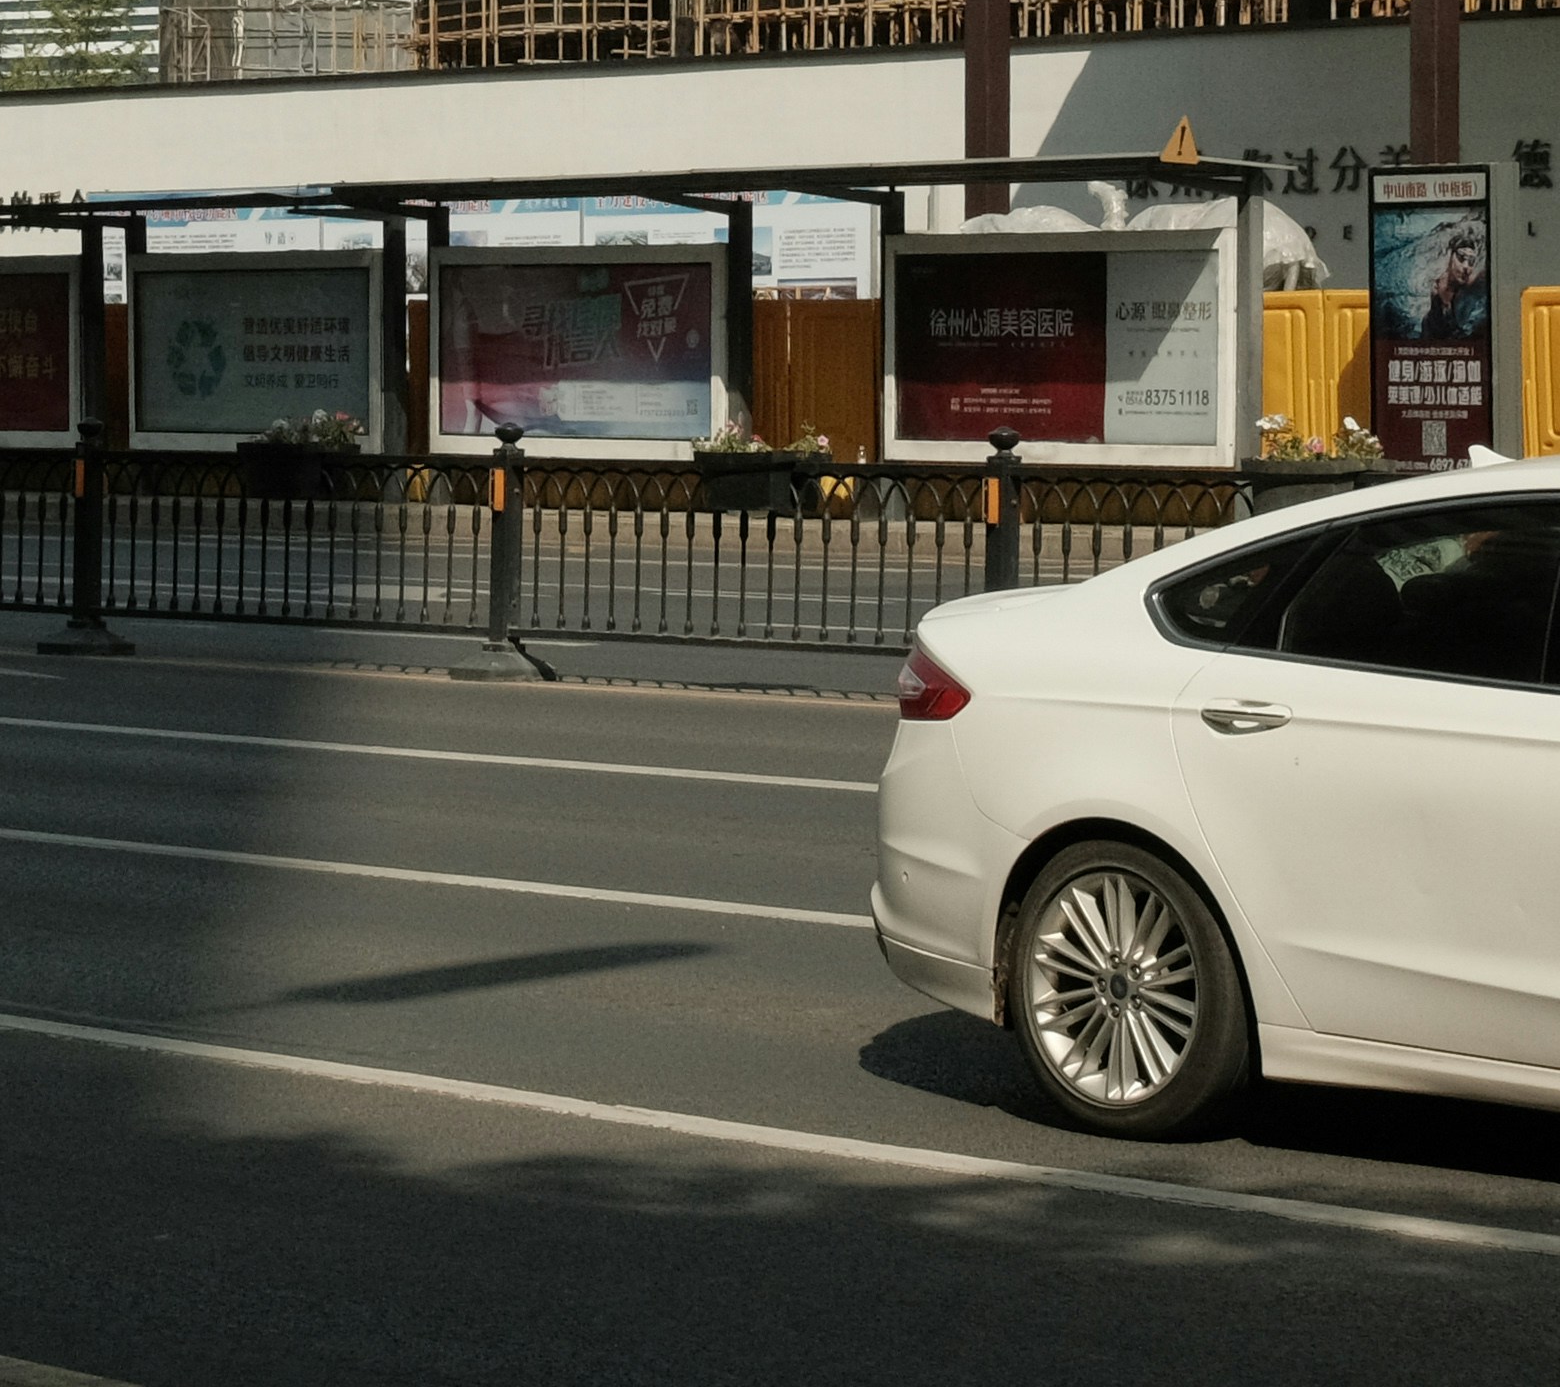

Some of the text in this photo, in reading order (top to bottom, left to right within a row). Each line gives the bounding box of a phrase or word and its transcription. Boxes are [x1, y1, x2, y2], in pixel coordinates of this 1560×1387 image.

[930, 308, 1075, 338] 徐州心源美容医院
